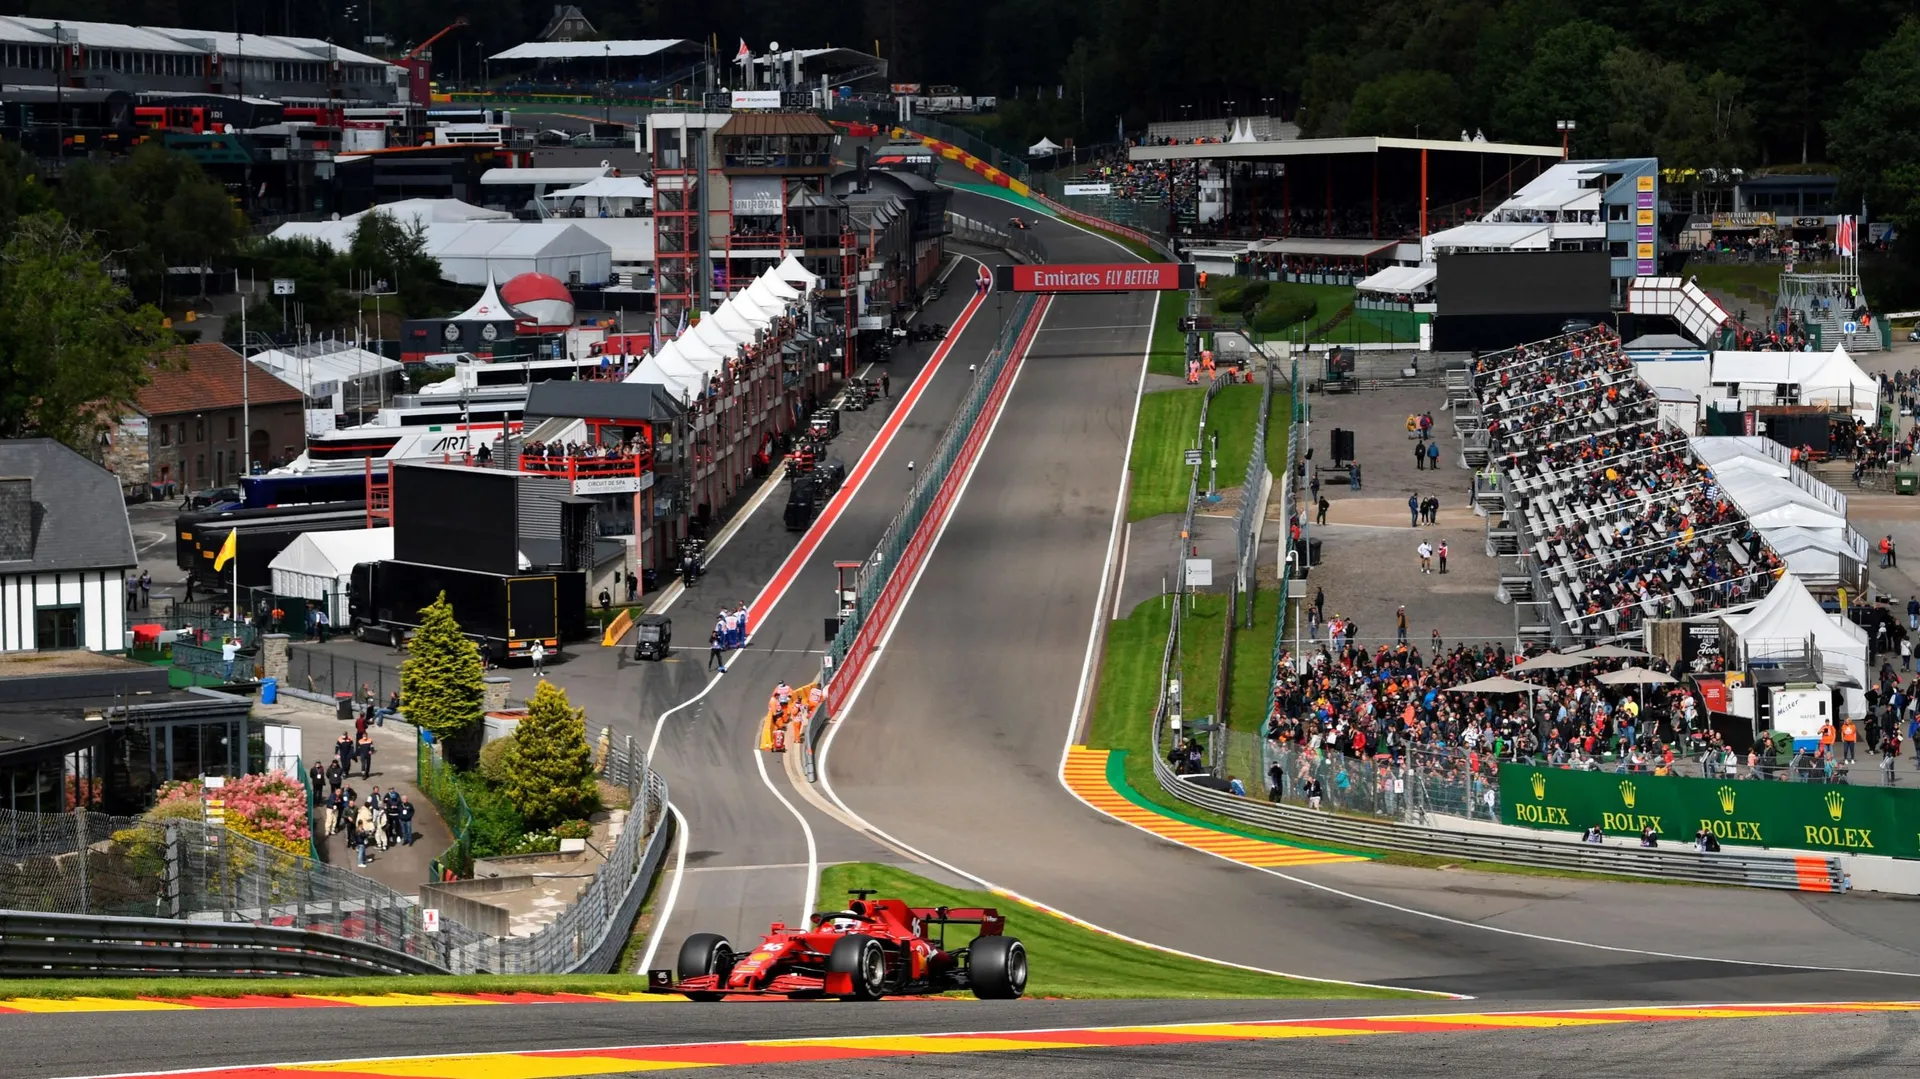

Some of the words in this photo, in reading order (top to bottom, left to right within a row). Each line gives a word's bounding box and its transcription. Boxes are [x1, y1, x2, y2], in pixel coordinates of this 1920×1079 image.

[787, 93, 813, 105] 12:06
[735, 200, 780, 210] UNIROYAL
[1034, 271, 1100, 286] Emirates
[1106, 271, 1122, 285] FLY
[1124, 269, 1160, 285] BETTER
[431, 436, 470, 451] ART
[1515, 803, 1570, 825] ROLEX
[1602, 812, 1664, 834] ROLEX
[1700, 819, 1762, 841] ROLEX
[1804, 825, 1874, 848] ROLEX
[912, 917, 921, 938] 16
[762, 943, 785, 951] 16
